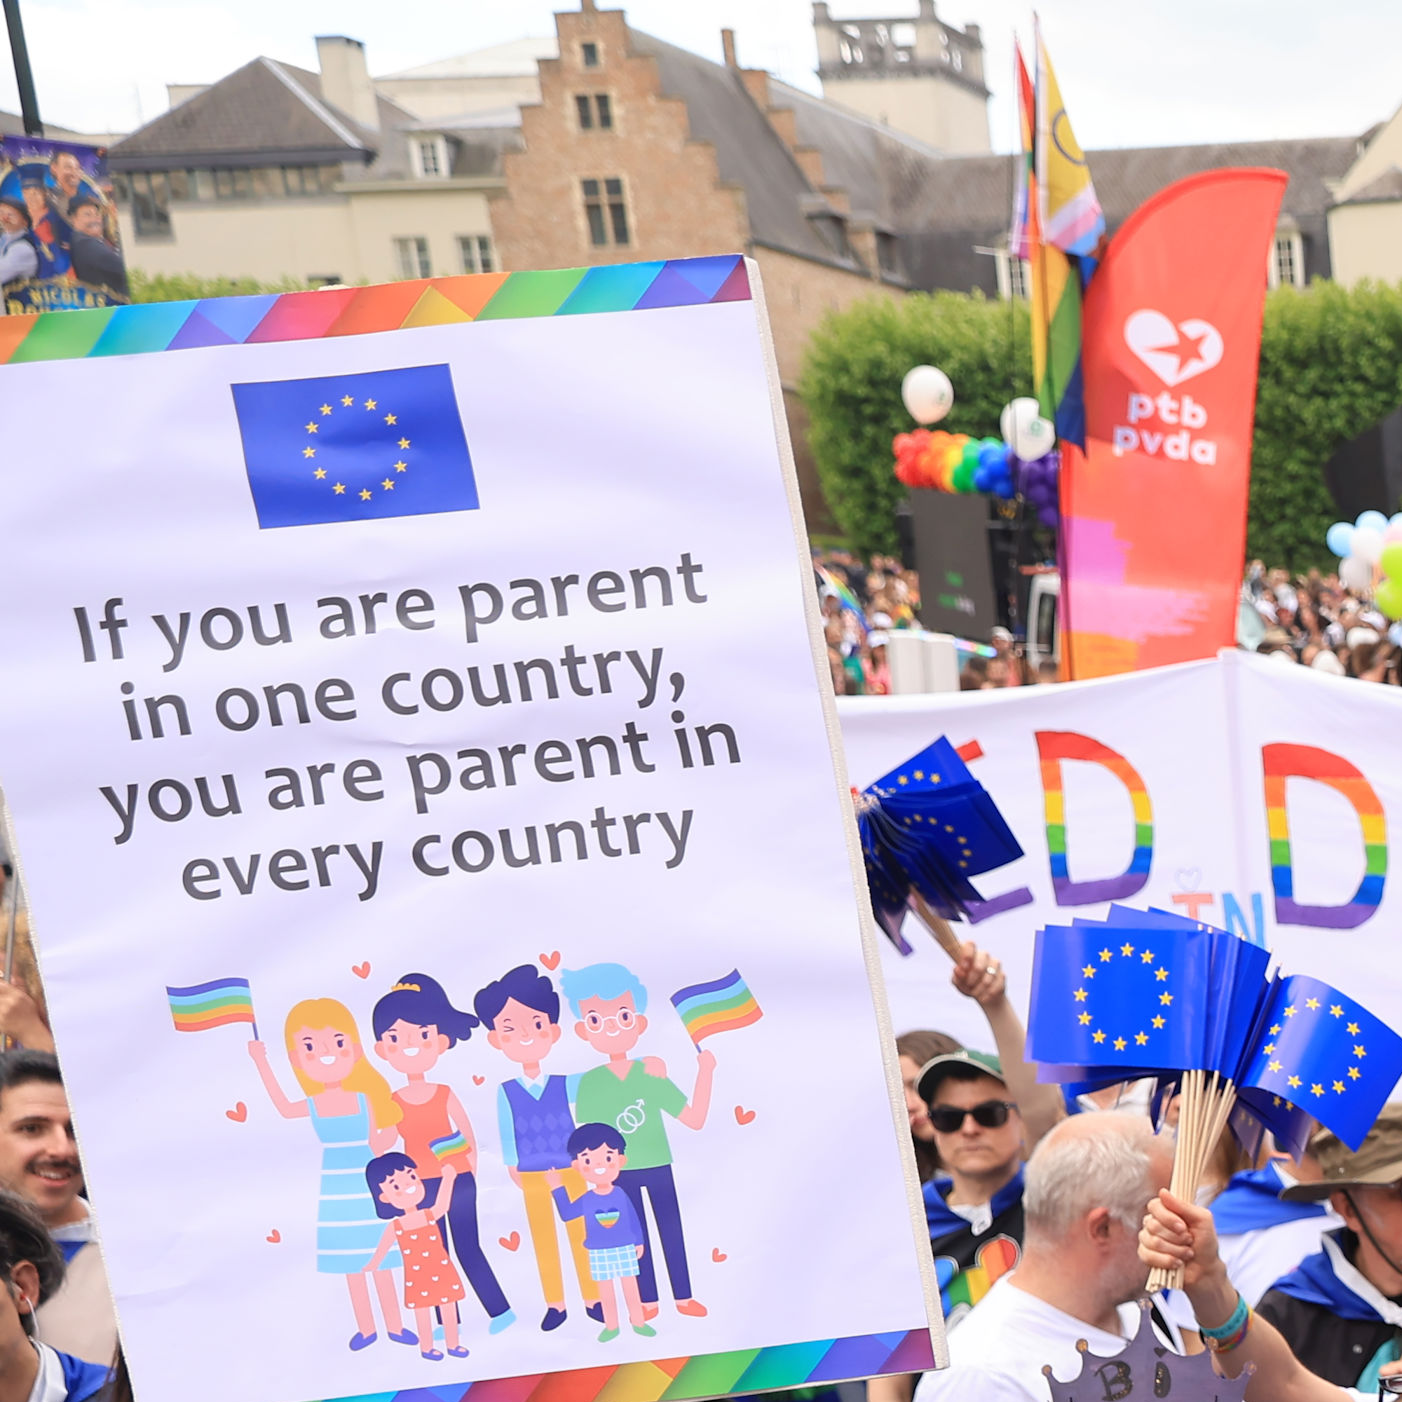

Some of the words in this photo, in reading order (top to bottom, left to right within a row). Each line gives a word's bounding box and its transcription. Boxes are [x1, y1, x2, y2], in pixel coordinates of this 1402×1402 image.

[1112, 424, 1218, 466] pvda
[1127, 390, 1208, 429] ptb
[74, 597, 128, 663] If
[151, 602, 293, 672] you
[316, 585, 435, 640] are
[458, 551, 708, 642] parent
[120, 681, 192, 741] in
[214, 675, 358, 735] one
[381, 644, 686, 716] country,
[100, 772, 242, 845] you
[264, 756, 385, 811] are
[406, 720, 656, 814] parent
[670, 711, 741, 769] in
[181, 839, 384, 902] every
[411, 804, 695, 878] country
